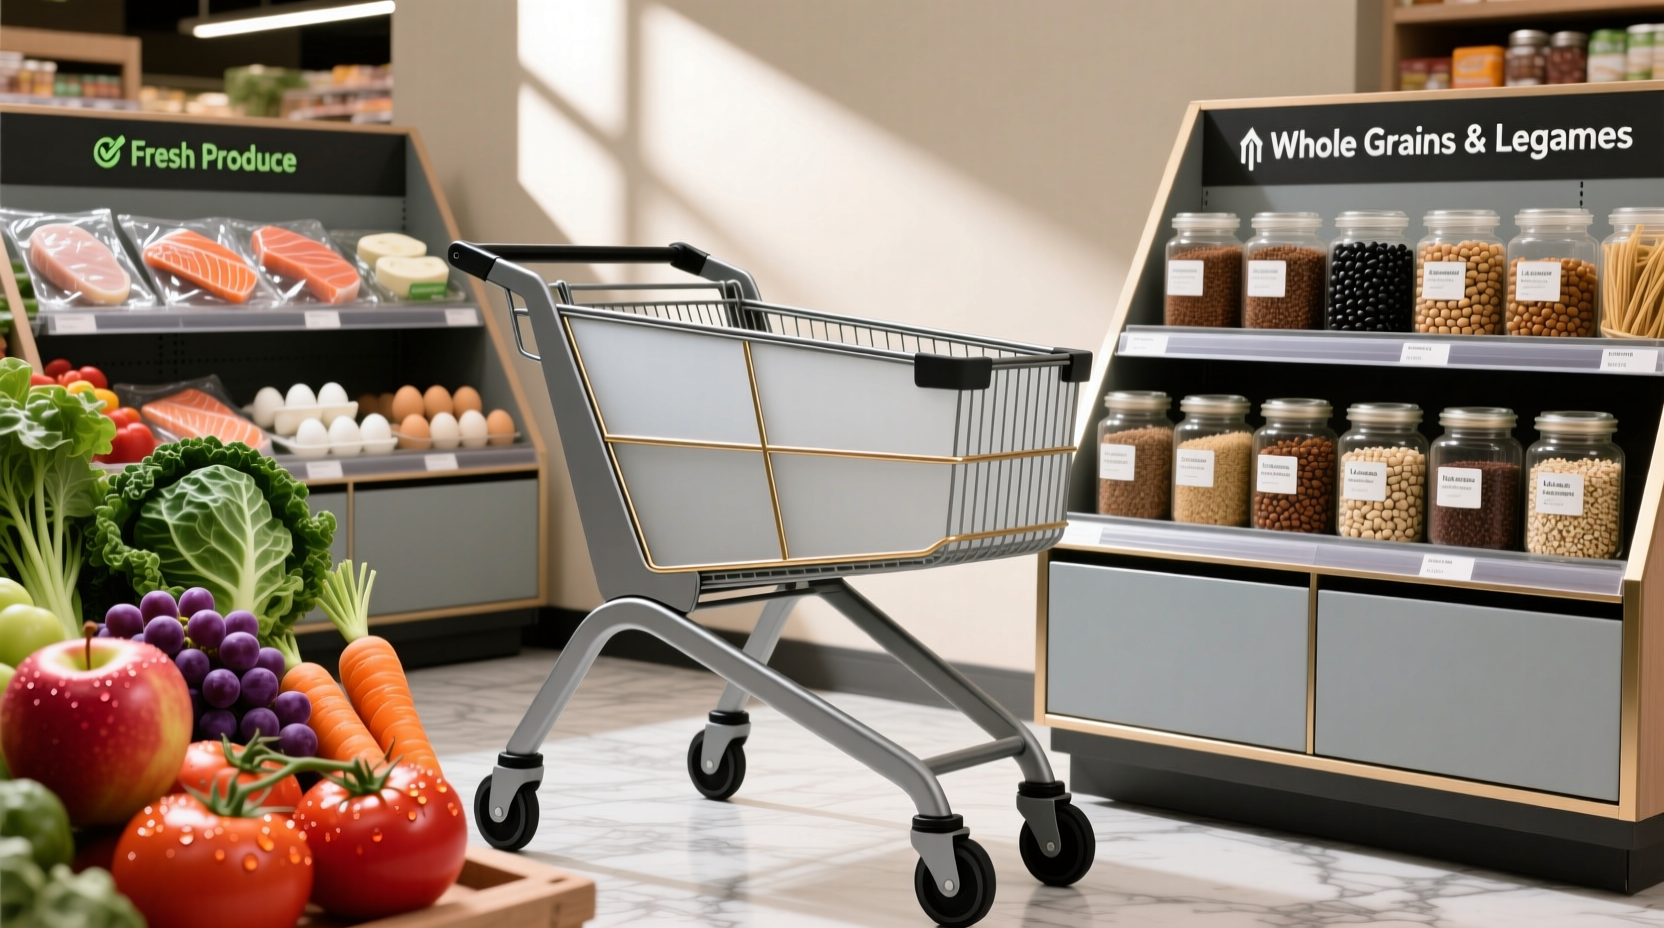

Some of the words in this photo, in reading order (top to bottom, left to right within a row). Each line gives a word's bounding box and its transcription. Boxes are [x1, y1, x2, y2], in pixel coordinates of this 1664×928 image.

[131, 139, 196, 169] Fresh
[201, 143, 298, 175] Produce
[1271, 128, 1357, 159] Whole
[1363, 125, 1457, 157] Grains
[1464, 123, 1487, 155] &
[1495, 122, 1634, 161] Legames
